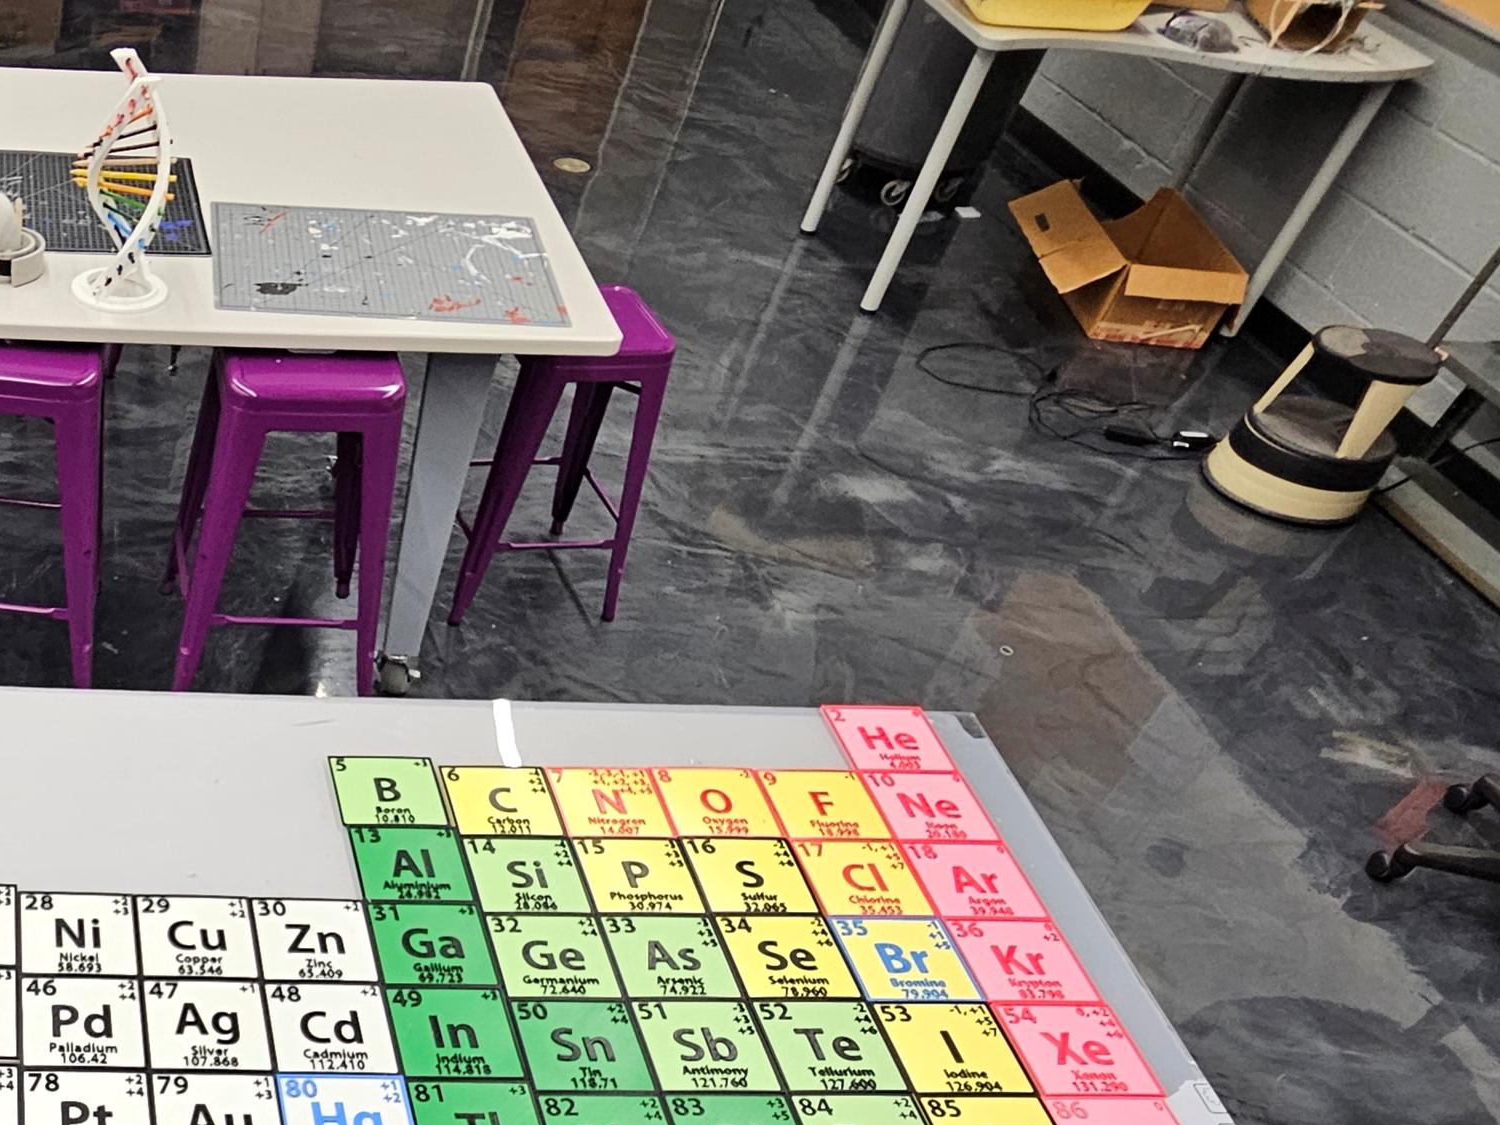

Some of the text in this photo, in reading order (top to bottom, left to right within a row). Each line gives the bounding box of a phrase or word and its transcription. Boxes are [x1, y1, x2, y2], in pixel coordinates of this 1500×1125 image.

[857, 726, 920, 751] He
[373, 777, 401, 802] B
[488, 787, 518, 813] C
[592, 787, 625, 814] N
[699, 789, 733, 814] O
[808, 791, 834, 816] F
[896, 792, 962, 819] Ne
[393, 849, 436, 878] Al
[506, 861, 549, 889] Si
[621, 861, 649, 888] P
[735, 860, 764, 888] S
[842, 863, 889, 892] Cl
[952, 865, 999, 894] Ar
[522, 940, 586, 971] Ge
[648, 940, 701, 971] As
[874, 943, 929, 974] Br
[990, 945, 1046, 976] Kr
[175, 1003, 240, 1045] Ag
[300, 1010, 364, 1044] Cd
[428, 1015, 479, 1049] In
[303, 1049, 368, 1060] Cadmium
[673, 1027, 738, 1062] Sb
[939, 1030, 964, 1064] I
[1040, 1031, 1114, 1066] Xe
[28, 1073, 60, 1092] 78
[683, 1065, 748, 1076] Antimony
[157, 1075, 188, 1094] 79
[285, 1079, 318, 1098] 80
[414, 1084, 444, 1103] 81
[544, 1097, 579, 1117] 82
[927, 1099, 961, 1117] 85
